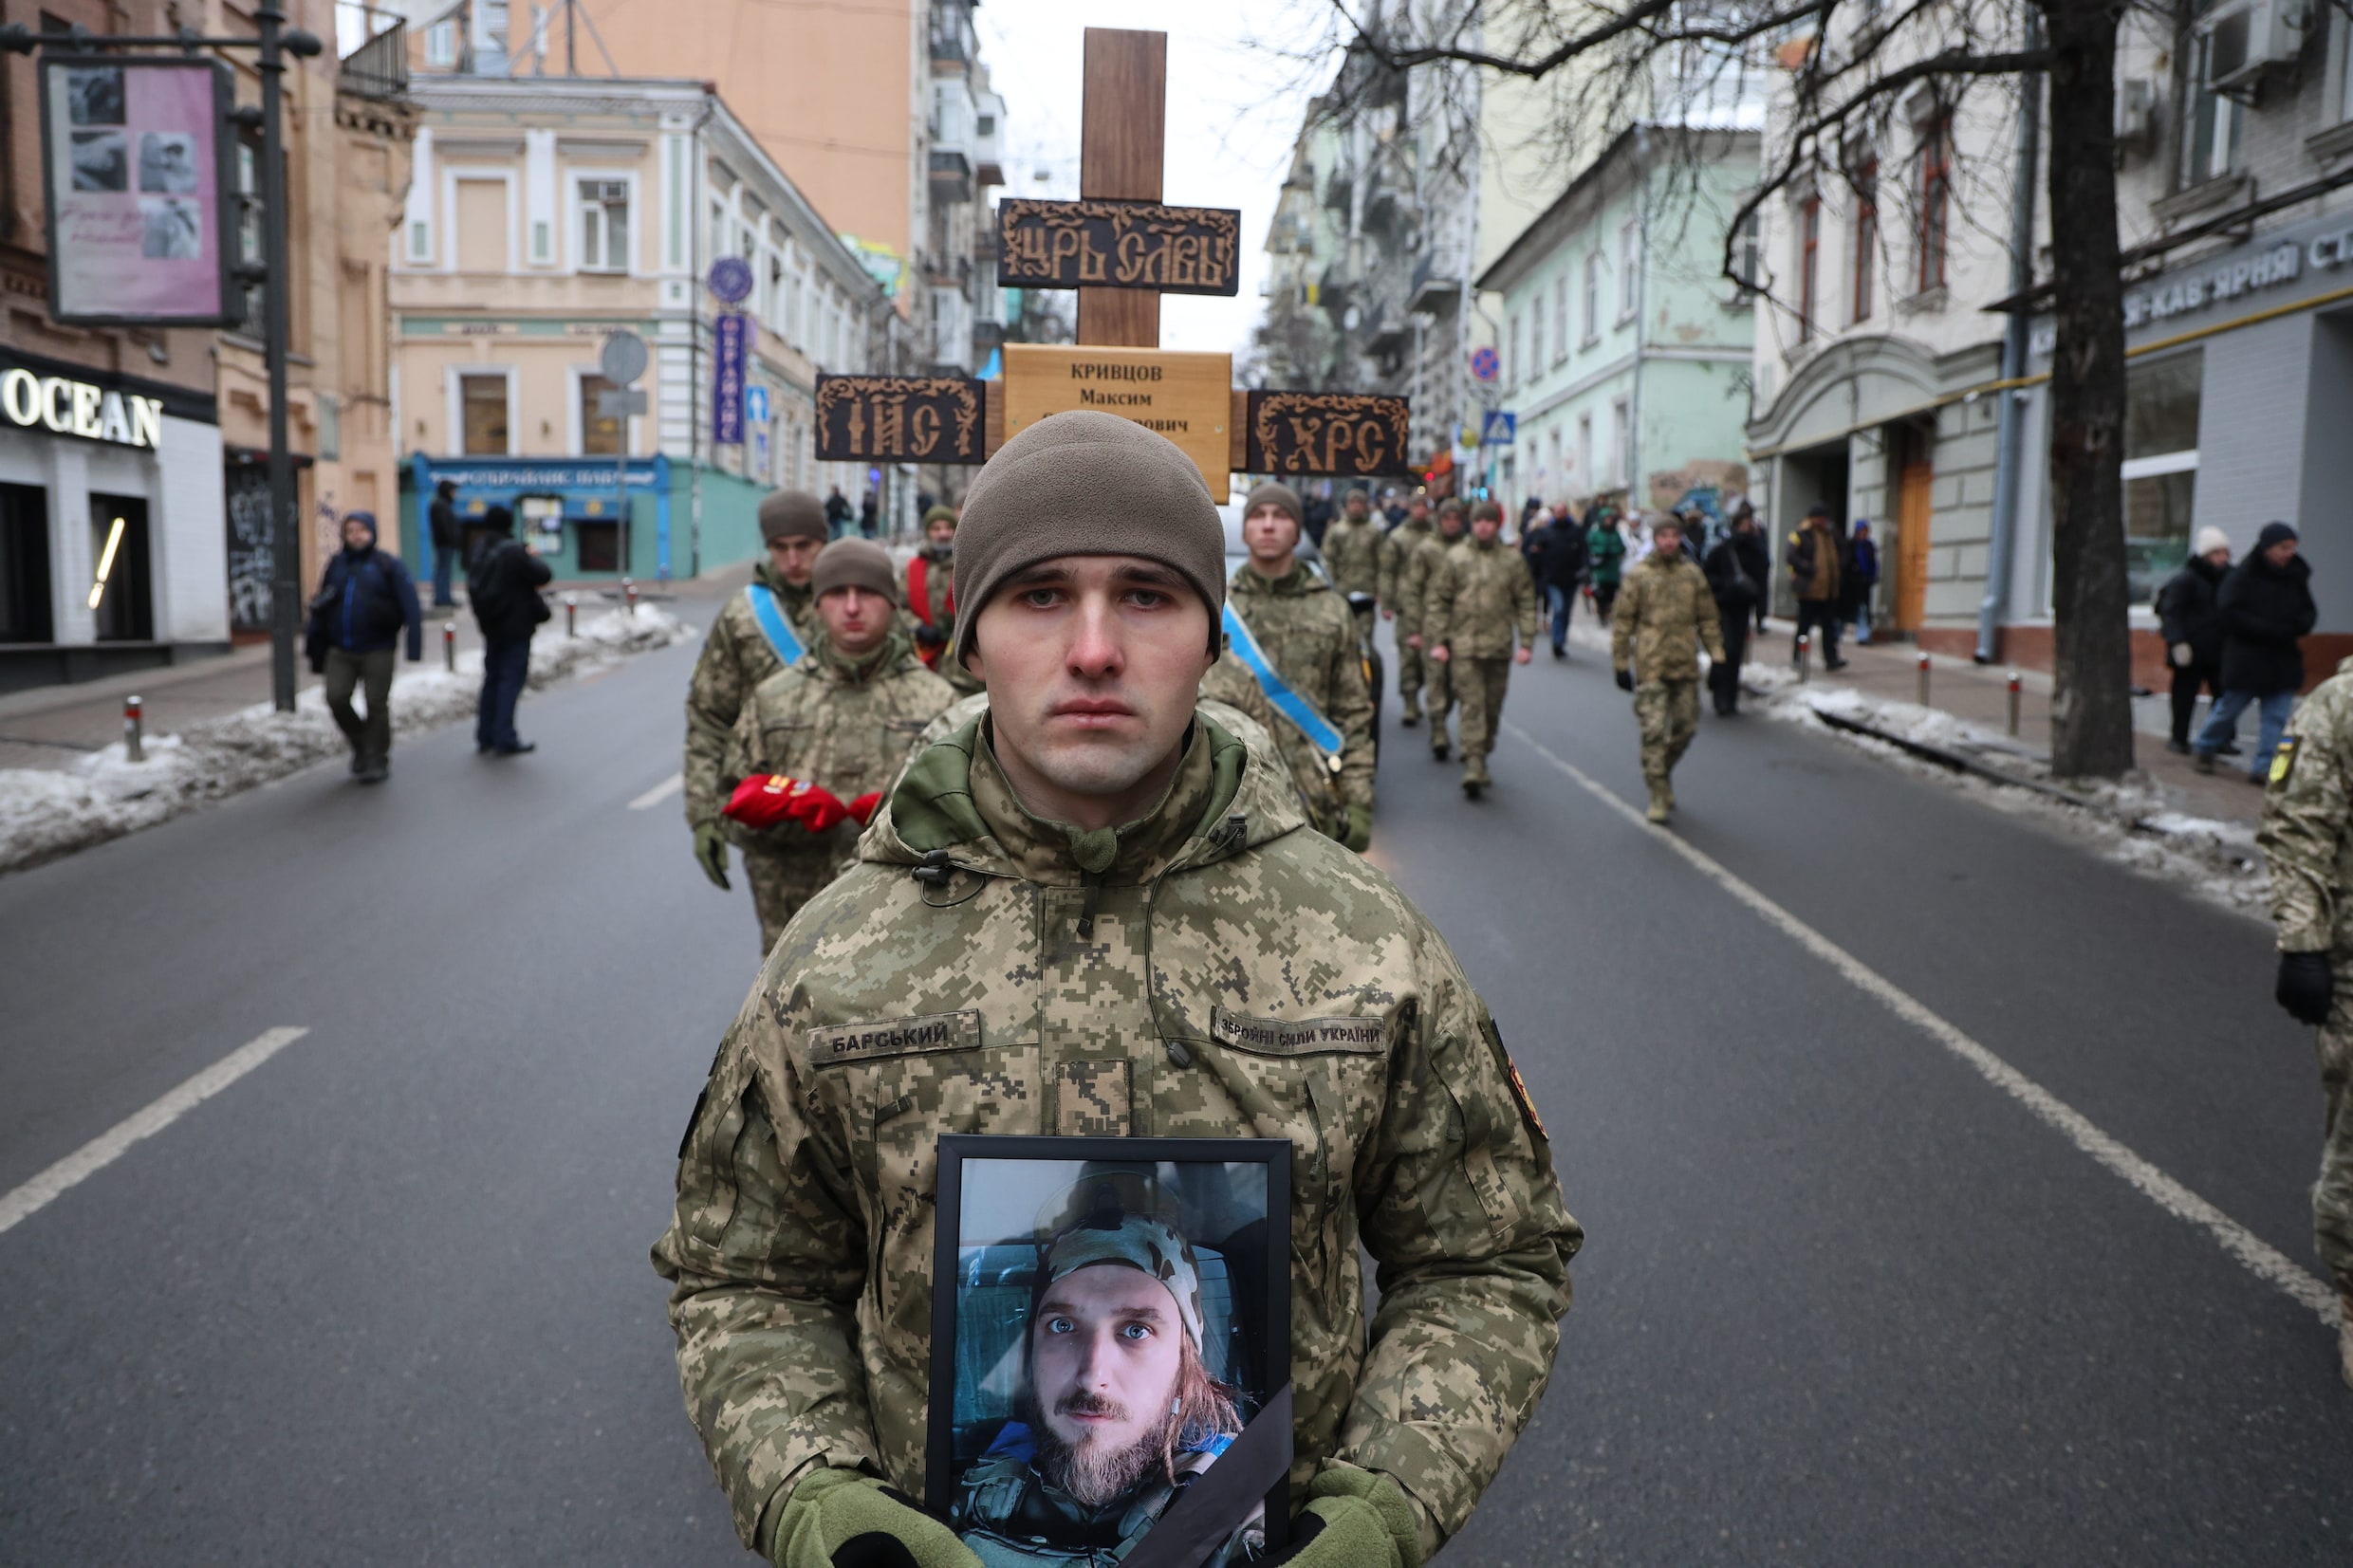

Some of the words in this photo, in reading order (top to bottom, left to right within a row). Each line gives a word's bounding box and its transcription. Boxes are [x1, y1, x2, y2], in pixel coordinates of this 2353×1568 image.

[1070, 362, 1163, 384] КРИВЦОВ
[1, 367, 164, 450] OCEAN
[1079, 388, 1153, 406] Максим
[832, 1020, 949, 1053] БАРСЬКИЙ
[1220, 1018, 1275, 1045] ЗБРОЙНІ
[1278, 1027, 1317, 1047] СИЛИ
[1320, 1025, 1381, 1043] УКРАЇНИ
